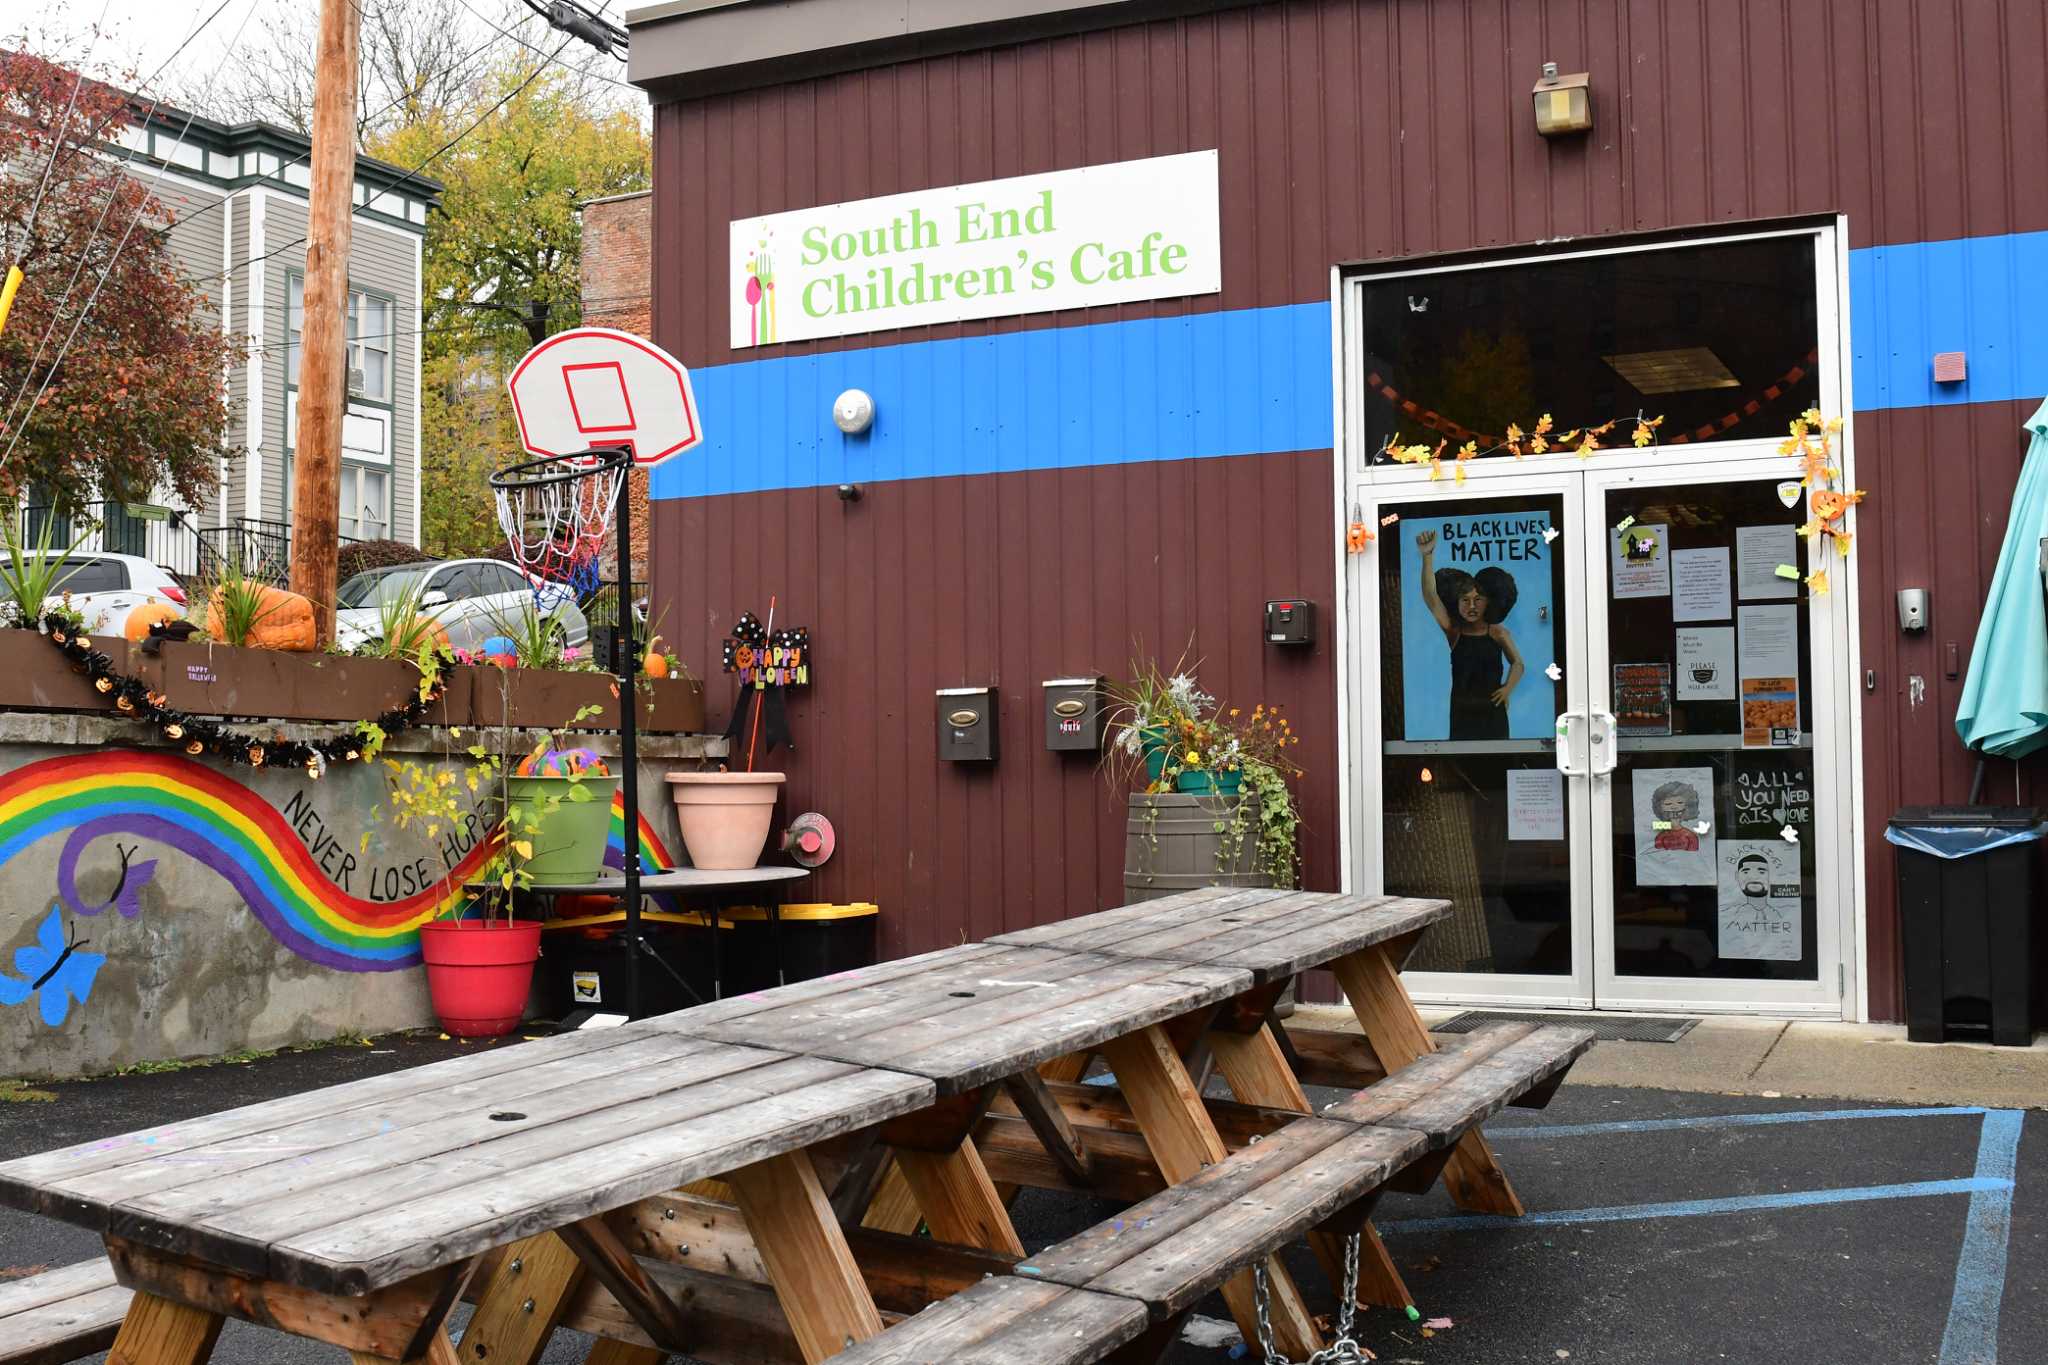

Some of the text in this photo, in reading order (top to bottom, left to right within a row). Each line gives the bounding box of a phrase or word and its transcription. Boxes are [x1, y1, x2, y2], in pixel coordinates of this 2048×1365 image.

[800, 189, 1056, 266] South End
[802, 231, 1188, 319] Children's Cafe
[1442, 519, 1546, 541] BLACK LIVES
[1451, 537, 1542, 561] MATTER
[187, 665, 209, 673] HAPPY
[752, 646, 801, 669] HAPPY
[1690, 662, 1716, 670] PLEASE
[738, 665, 809, 690] HALLOWEEN
[1752, 771, 1795, 788] ALL
[1781, 786, 1810, 809] NEED
[1750, 806, 1809, 824] IS LOVE
[283, 789, 494, 902] NEVER LOSE HOPE
[1726, 920, 1793, 934] MATTER
